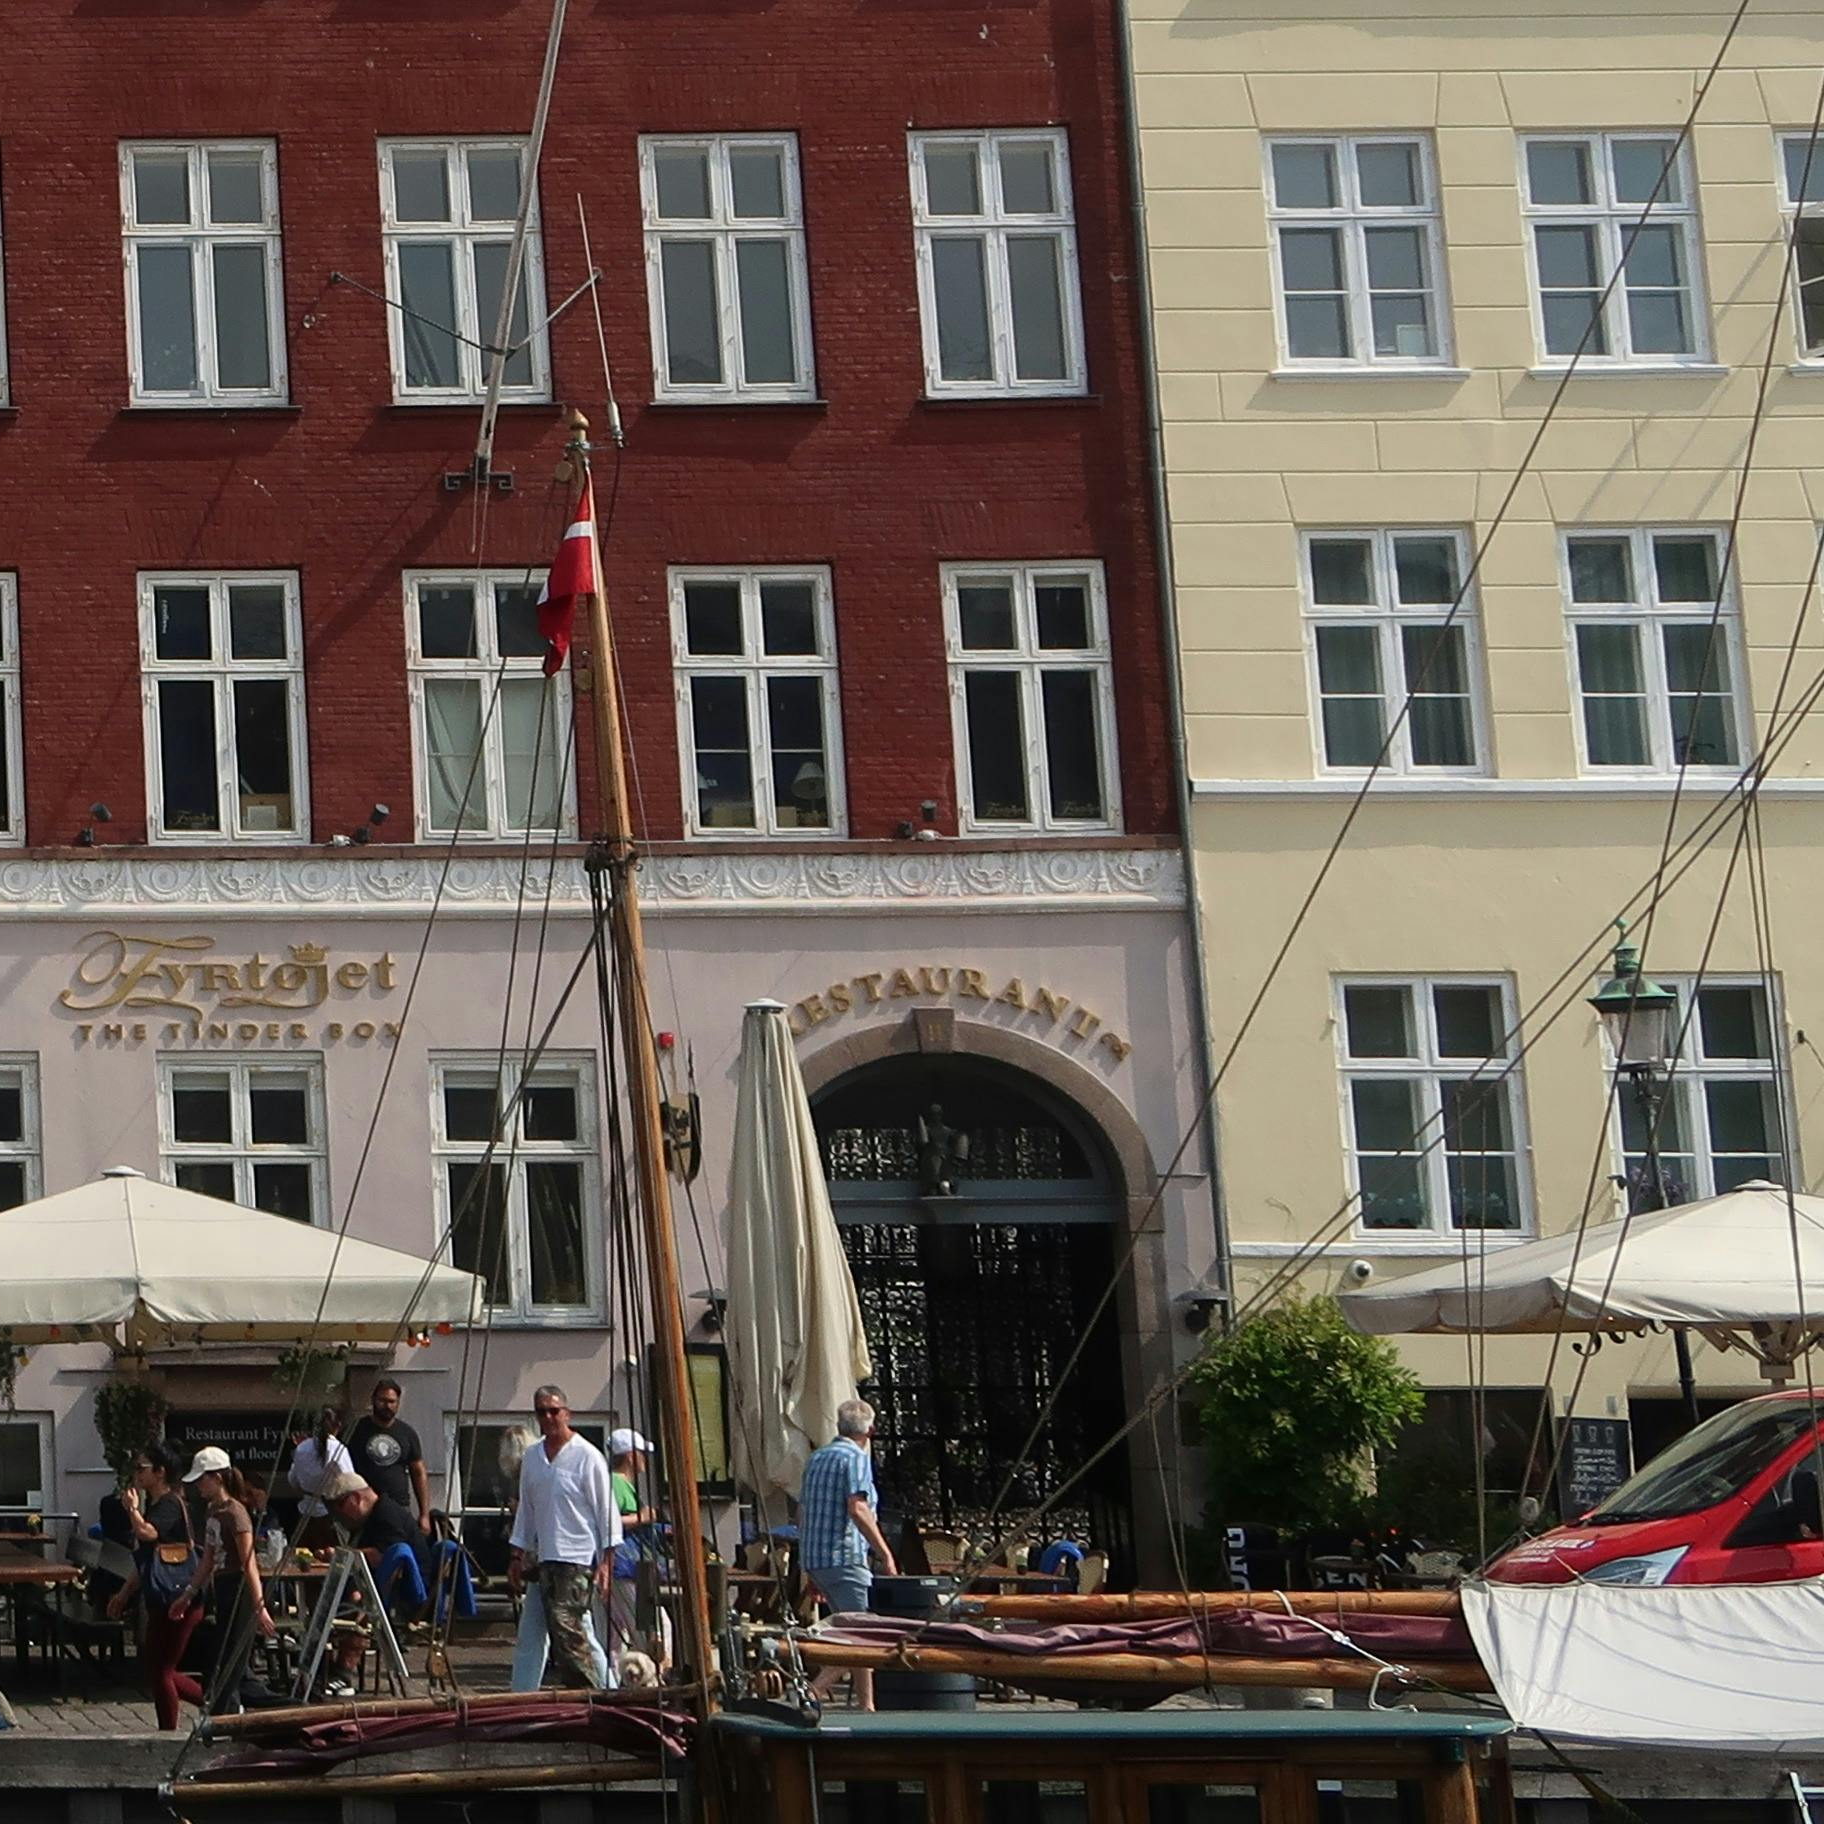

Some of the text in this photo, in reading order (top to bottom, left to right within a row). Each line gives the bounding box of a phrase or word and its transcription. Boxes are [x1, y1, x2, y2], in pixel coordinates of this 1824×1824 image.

[788, 967, 1101, 1039] ESTAURANT
[74, 1024, 401, 1041] THE TINDER BOX
[185, 1426, 260, 1441] Restaurant
